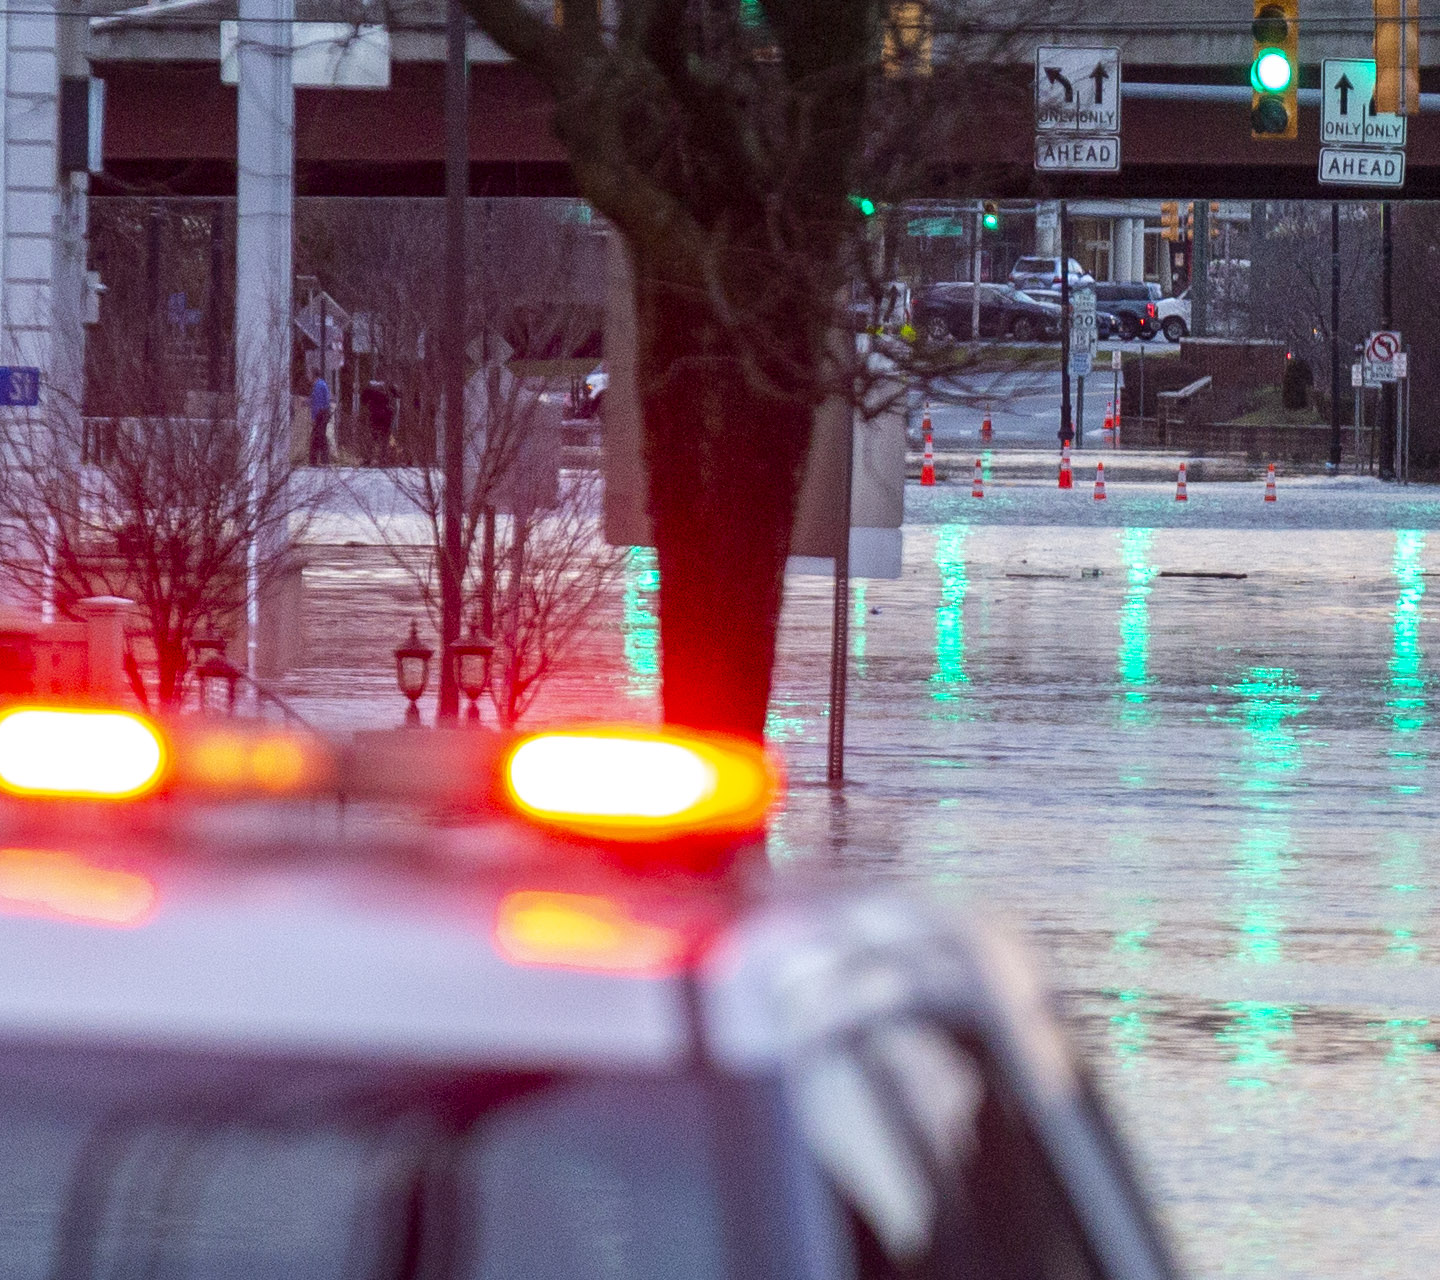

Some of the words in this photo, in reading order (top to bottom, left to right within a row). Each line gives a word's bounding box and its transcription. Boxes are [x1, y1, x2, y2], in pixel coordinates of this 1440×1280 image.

[1080, 111, 1115, 124] ONLY
[1325, 121, 1361, 135] ONLY
[1365, 123, 1401, 138] ONLY
[1043, 144, 1111, 161] AHEAD
[1328, 157, 1395, 176] AHEAD
